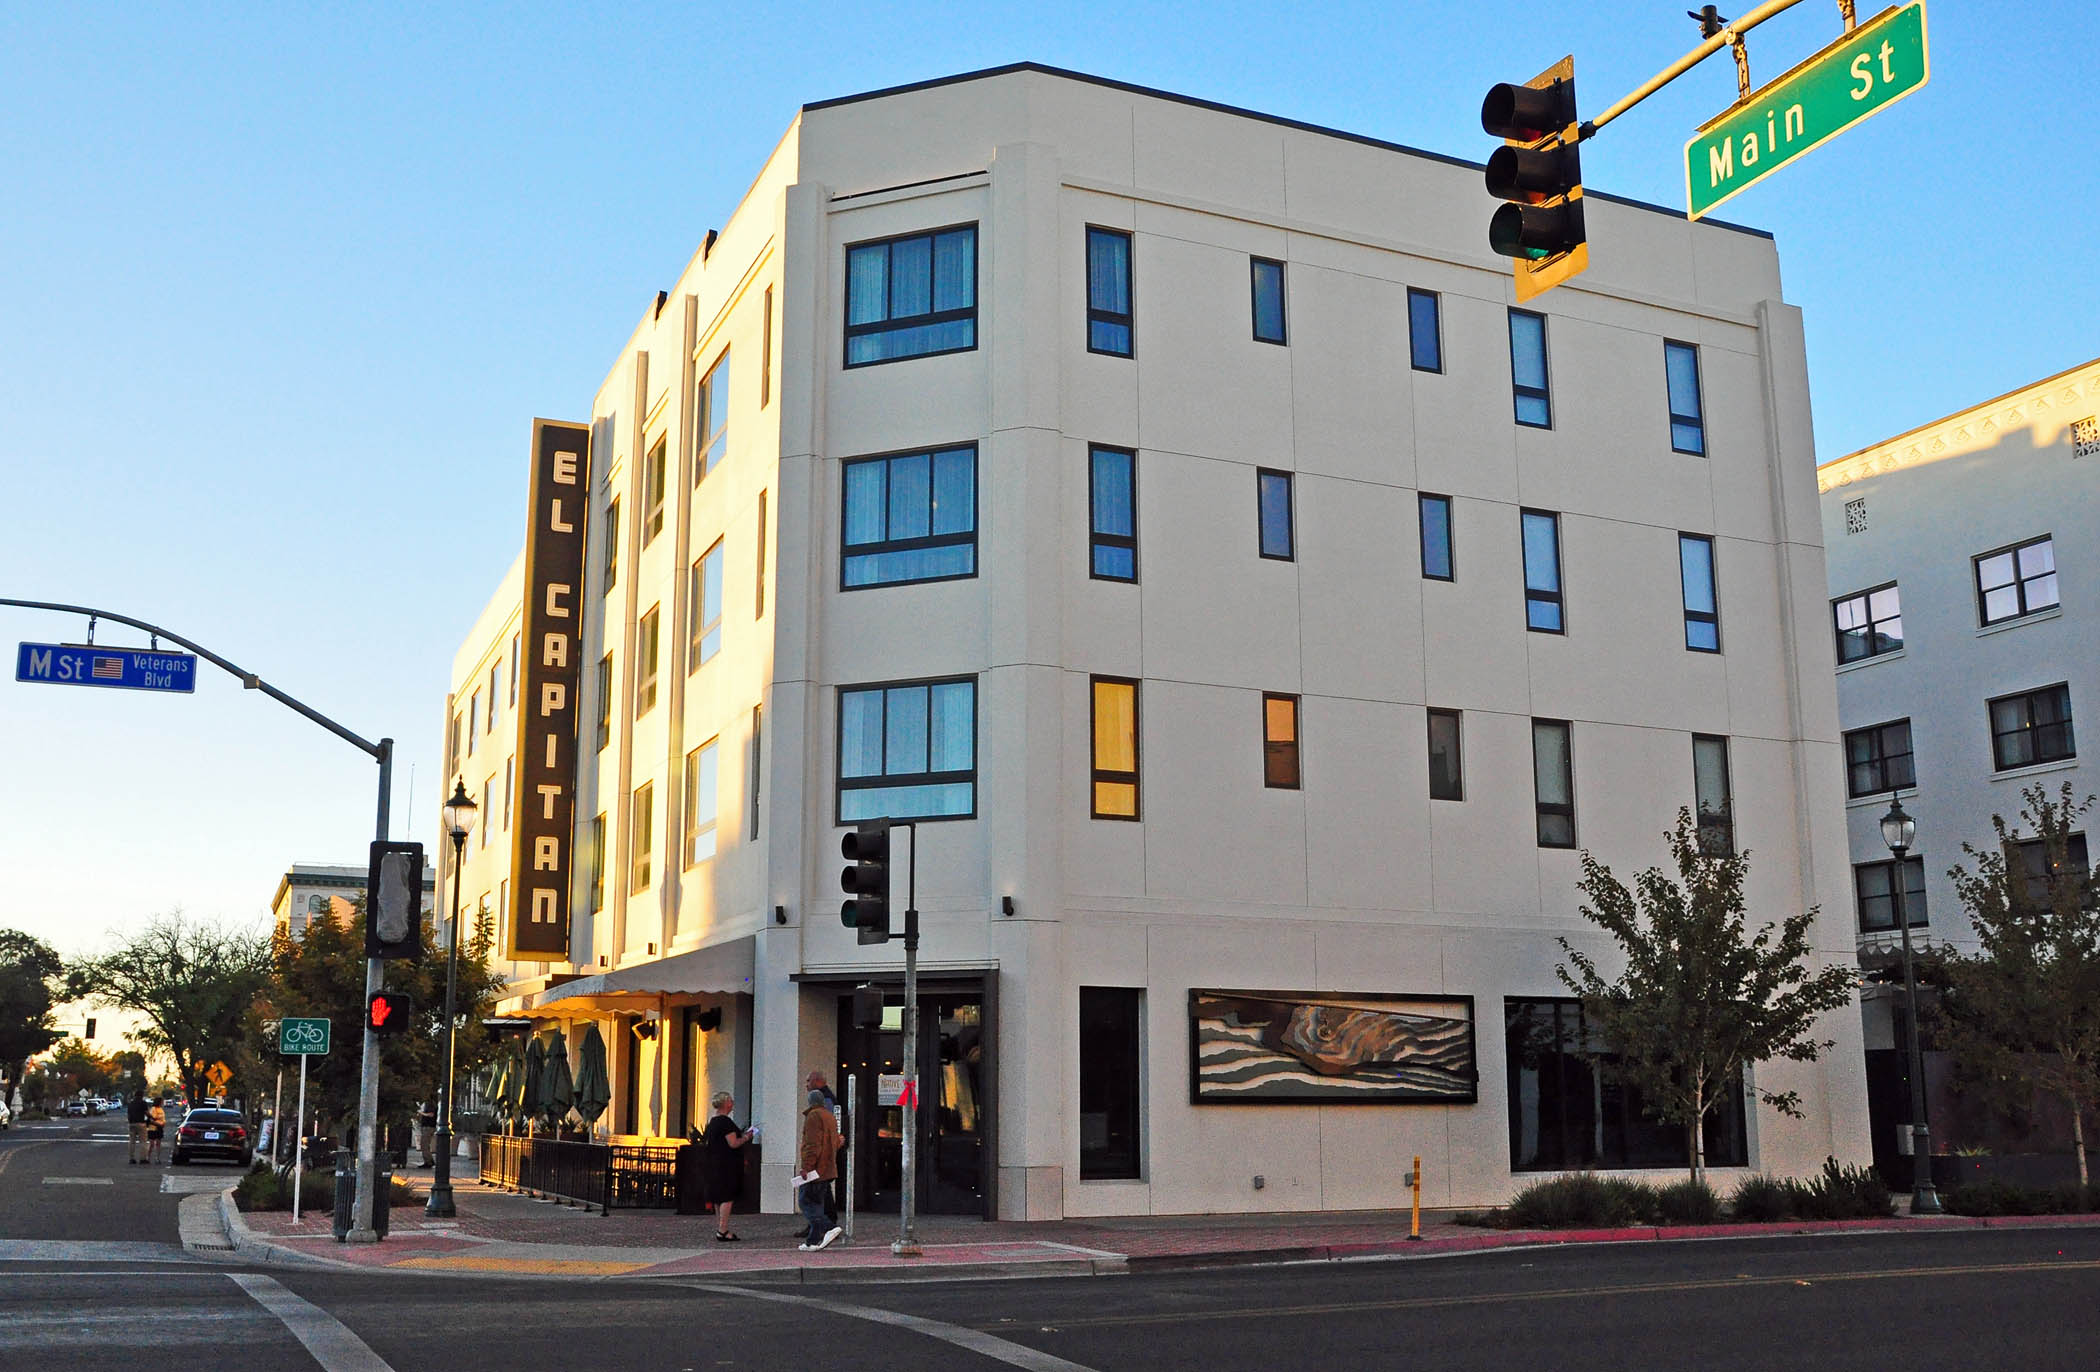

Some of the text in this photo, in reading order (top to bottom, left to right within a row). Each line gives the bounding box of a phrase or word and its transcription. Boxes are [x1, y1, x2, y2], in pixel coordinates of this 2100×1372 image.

[1709, 39, 1896, 188] Main St
[29, 648, 84, 680] M St
[133, 654, 188, 672] Veterans
[144, 671, 172, 688] Blvd
[530, 450, 578, 924] EL CAPITAN
[284, 1043, 326, 1052] BIKE ROUTE
